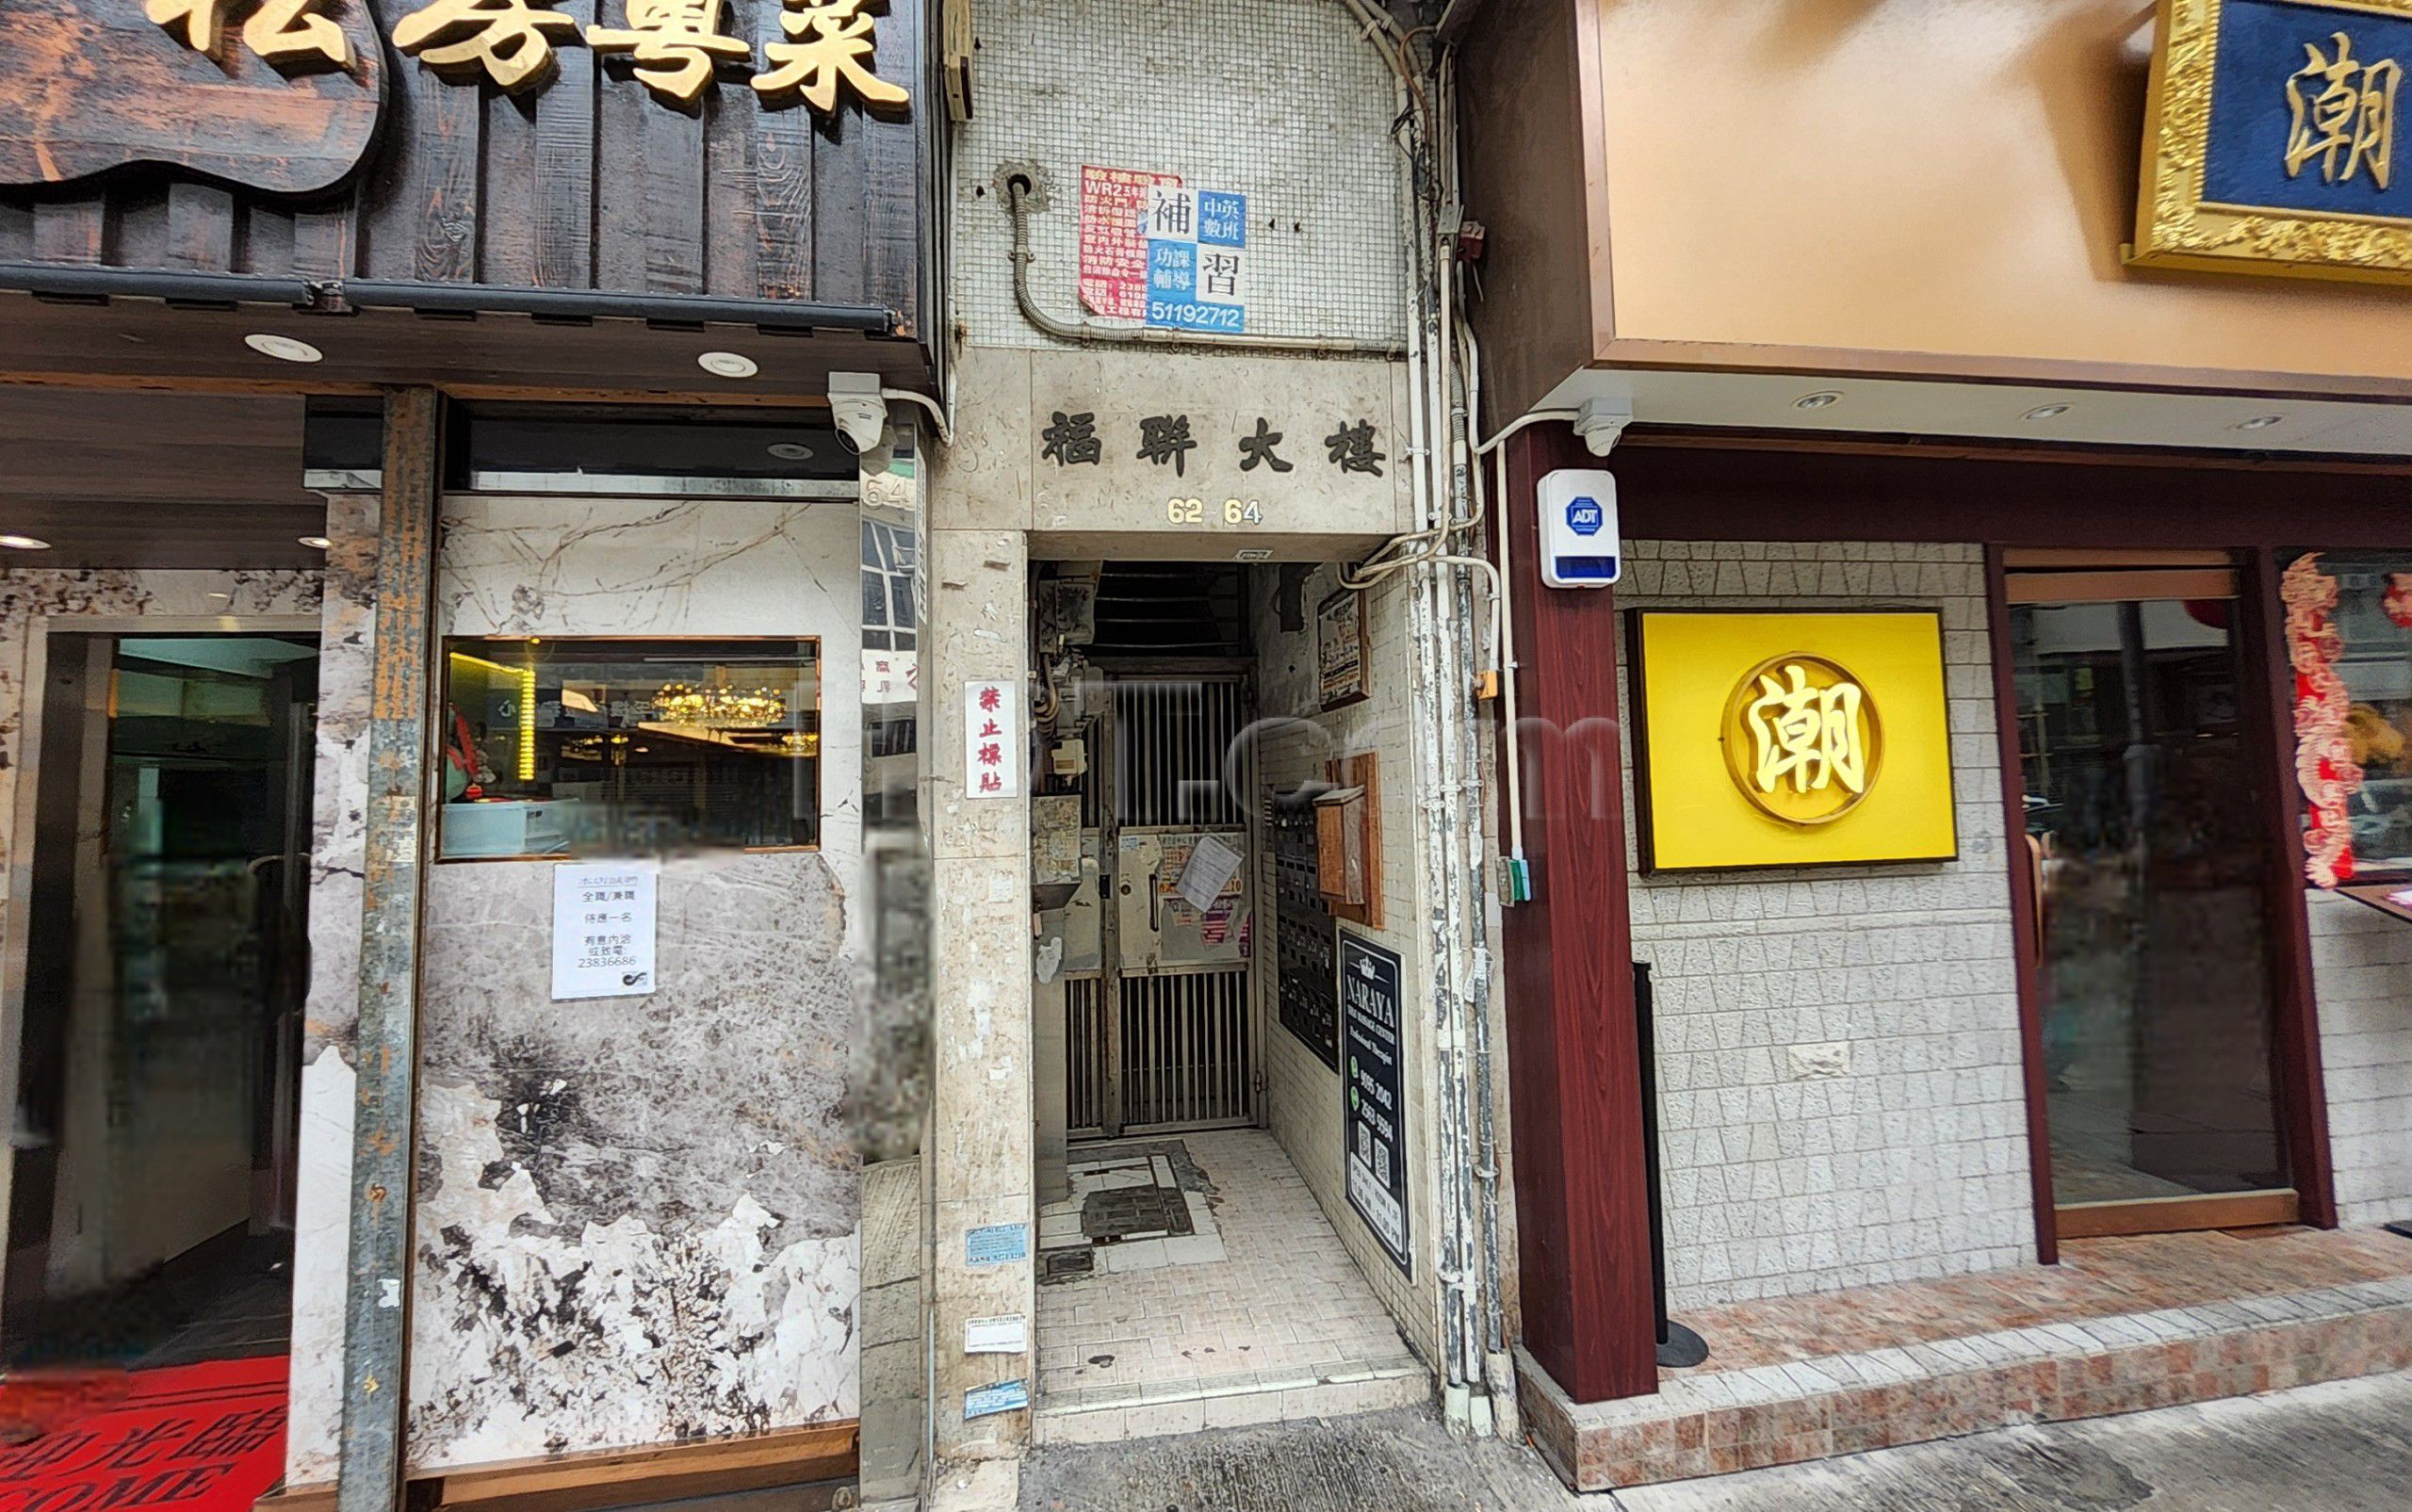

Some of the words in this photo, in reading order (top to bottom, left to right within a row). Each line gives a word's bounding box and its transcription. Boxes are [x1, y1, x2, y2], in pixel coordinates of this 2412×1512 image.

[2284, 32, 2402, 189] 潮
[1152, 189, 1191, 235] 補
[1204, 197, 1240, 219] 中英
[1204, 219, 1240, 240] 數班
[1155, 248, 1190, 268] 功課
[1153, 268, 1191, 290] 輔導
[1203, 253, 1239, 296] 習
[1151, 301, 1240, 327] 51192712
[1042, 411, 1386, 478] 福聯大樓
[1167, 498, 1204, 524] 62
[1224, 499, 1263, 526] 64
[1573, 509, 1598, 524] ADT
[977, 686, 1002, 793] 禁止標貼
[1748, 665, 1865, 793] 潮
[578, 955, 637, 968] 23836686
[1346, 974, 1394, 1028] NARAYA
